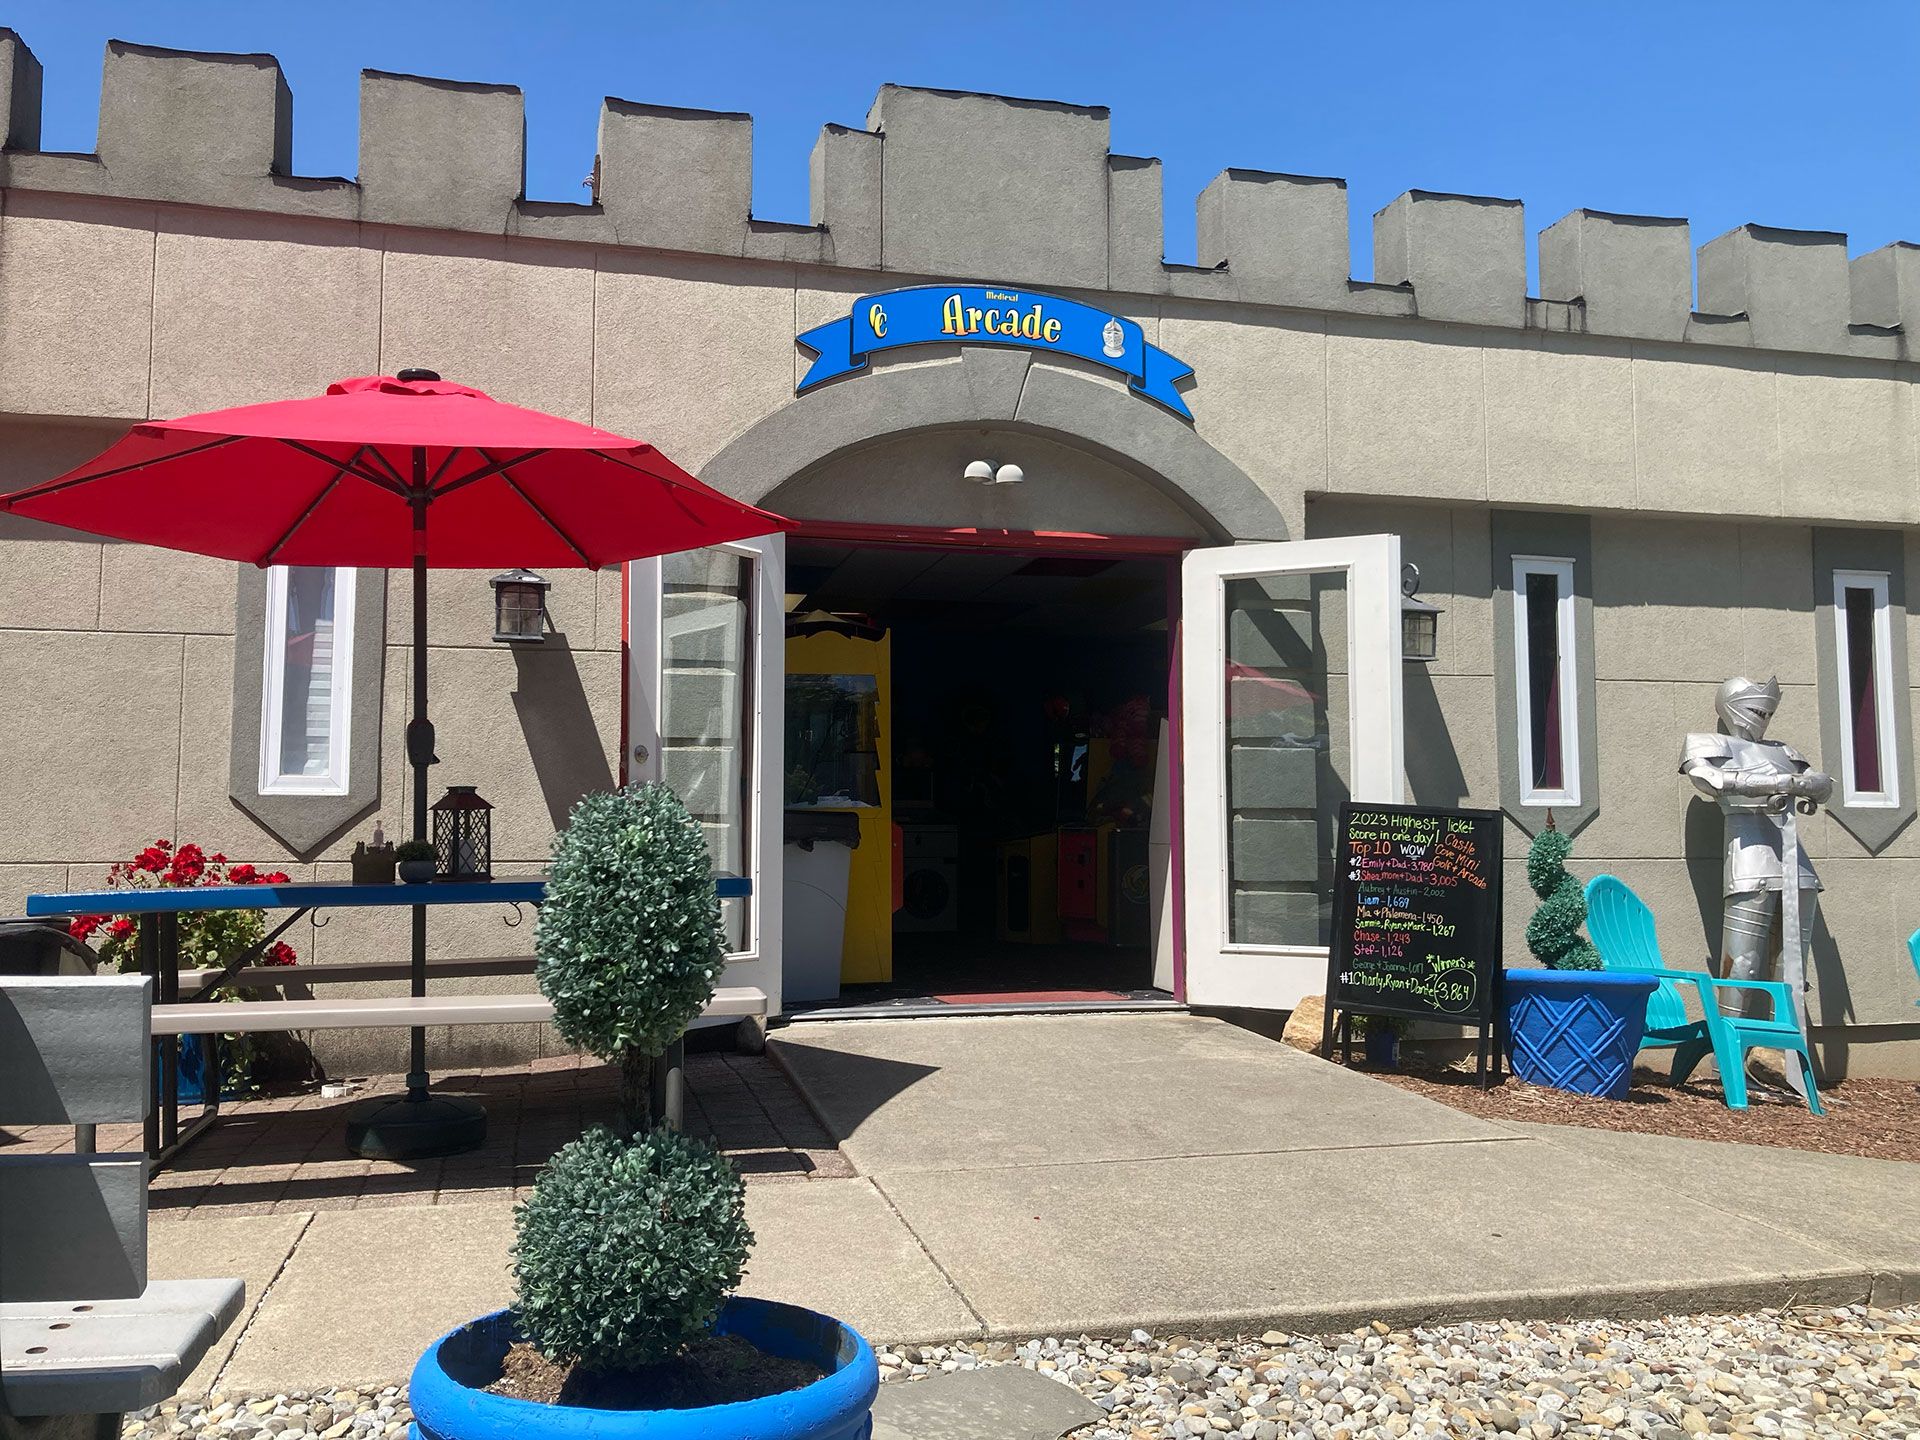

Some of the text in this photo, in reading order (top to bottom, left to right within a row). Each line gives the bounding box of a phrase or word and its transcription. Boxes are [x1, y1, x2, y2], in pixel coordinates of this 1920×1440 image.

[986, 291, 1018, 302] Medieval
[941, 294, 1062, 342] Arcade
[1350, 812, 1475, 834] 2023 Highest Ticket
[1349, 827, 1377, 840] Score
[1380, 830, 1390, 840] in
[1392, 833, 1411, 842] one
[1349, 840, 1392, 857] Top 10
[1400, 844, 1426, 856] WOW
[1445, 833, 1476, 855] Castle
[1361, 857, 1385, 871] Emily
[1435, 844, 1481, 871] Cove Mini
[1429, 873, 1459, 887] 3,005
[1432, 856, 1453, 871] Golf
[1457, 867, 1488, 890] Arcade
[1358, 881, 1385, 895] Aubrey
[1393, 884, 1418, 895] Austin
[1358, 893, 1380, 905] Liam
[1356, 905, 1372, 918] Mia
[1353, 930, 1380, 942] Chase
[1353, 944, 1375, 956] Stef
[1339, 971, 1353, 985] #1
[1438, 982, 1469, 1001] 3,864
